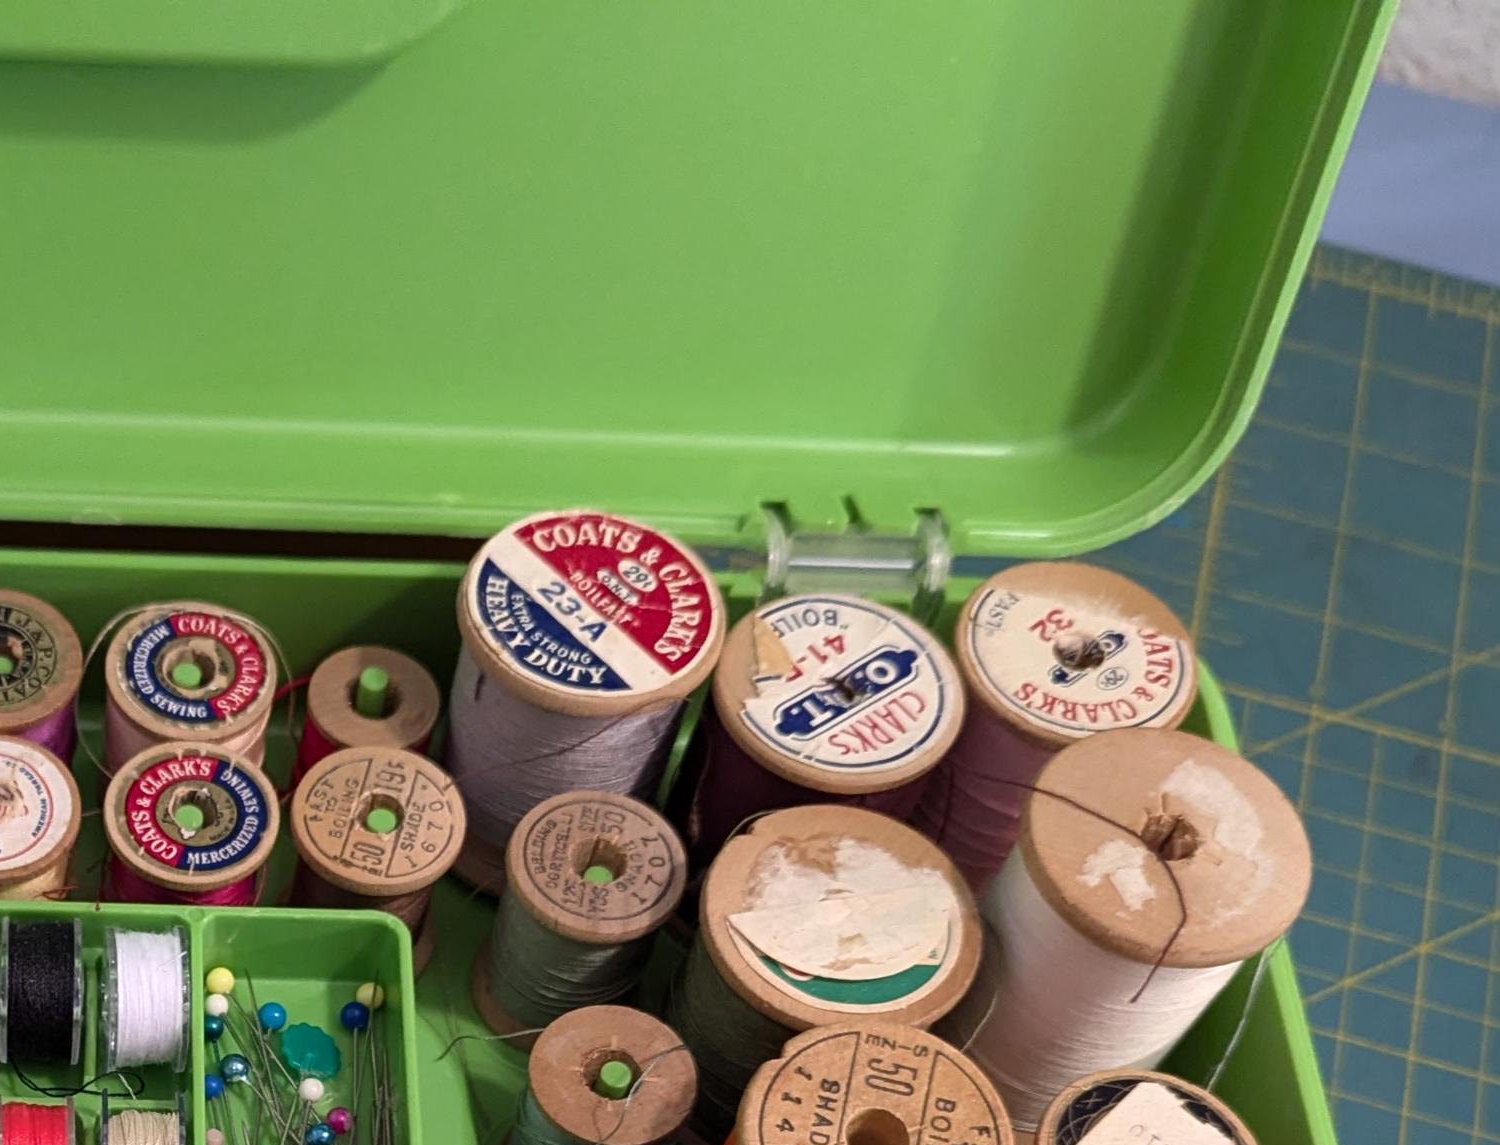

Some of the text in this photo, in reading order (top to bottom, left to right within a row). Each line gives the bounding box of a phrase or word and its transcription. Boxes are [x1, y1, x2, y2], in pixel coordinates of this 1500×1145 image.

[532, 521, 701, 662] COATS CLARK'S
[538, 581, 608, 643] 23-A
[570, 570, 634, 628] BOILFAST
[486, 576, 607, 684] HEAVY DUTY
[511, 594, 593, 664] EXTRA STRONG
[1028, 608, 1074, 642] 32
[134, 625, 208, 718] MERCERIZED SEWING
[178, 616, 259, 714] COATS CLARK'S
[828, 690, 926, 755] CLARK'S
[1013, 682, 1138, 723] CLARK'S
[131, 758, 211, 860] COATS CLARK'S
[186, 770, 259, 865] MERCERIZED SEWING
[329, 777, 359, 839] BOILING
[400, 802, 426, 852] SHADE
[864, 1033, 929, 1058] SIZE
[864, 1057, 918, 1097] 50
